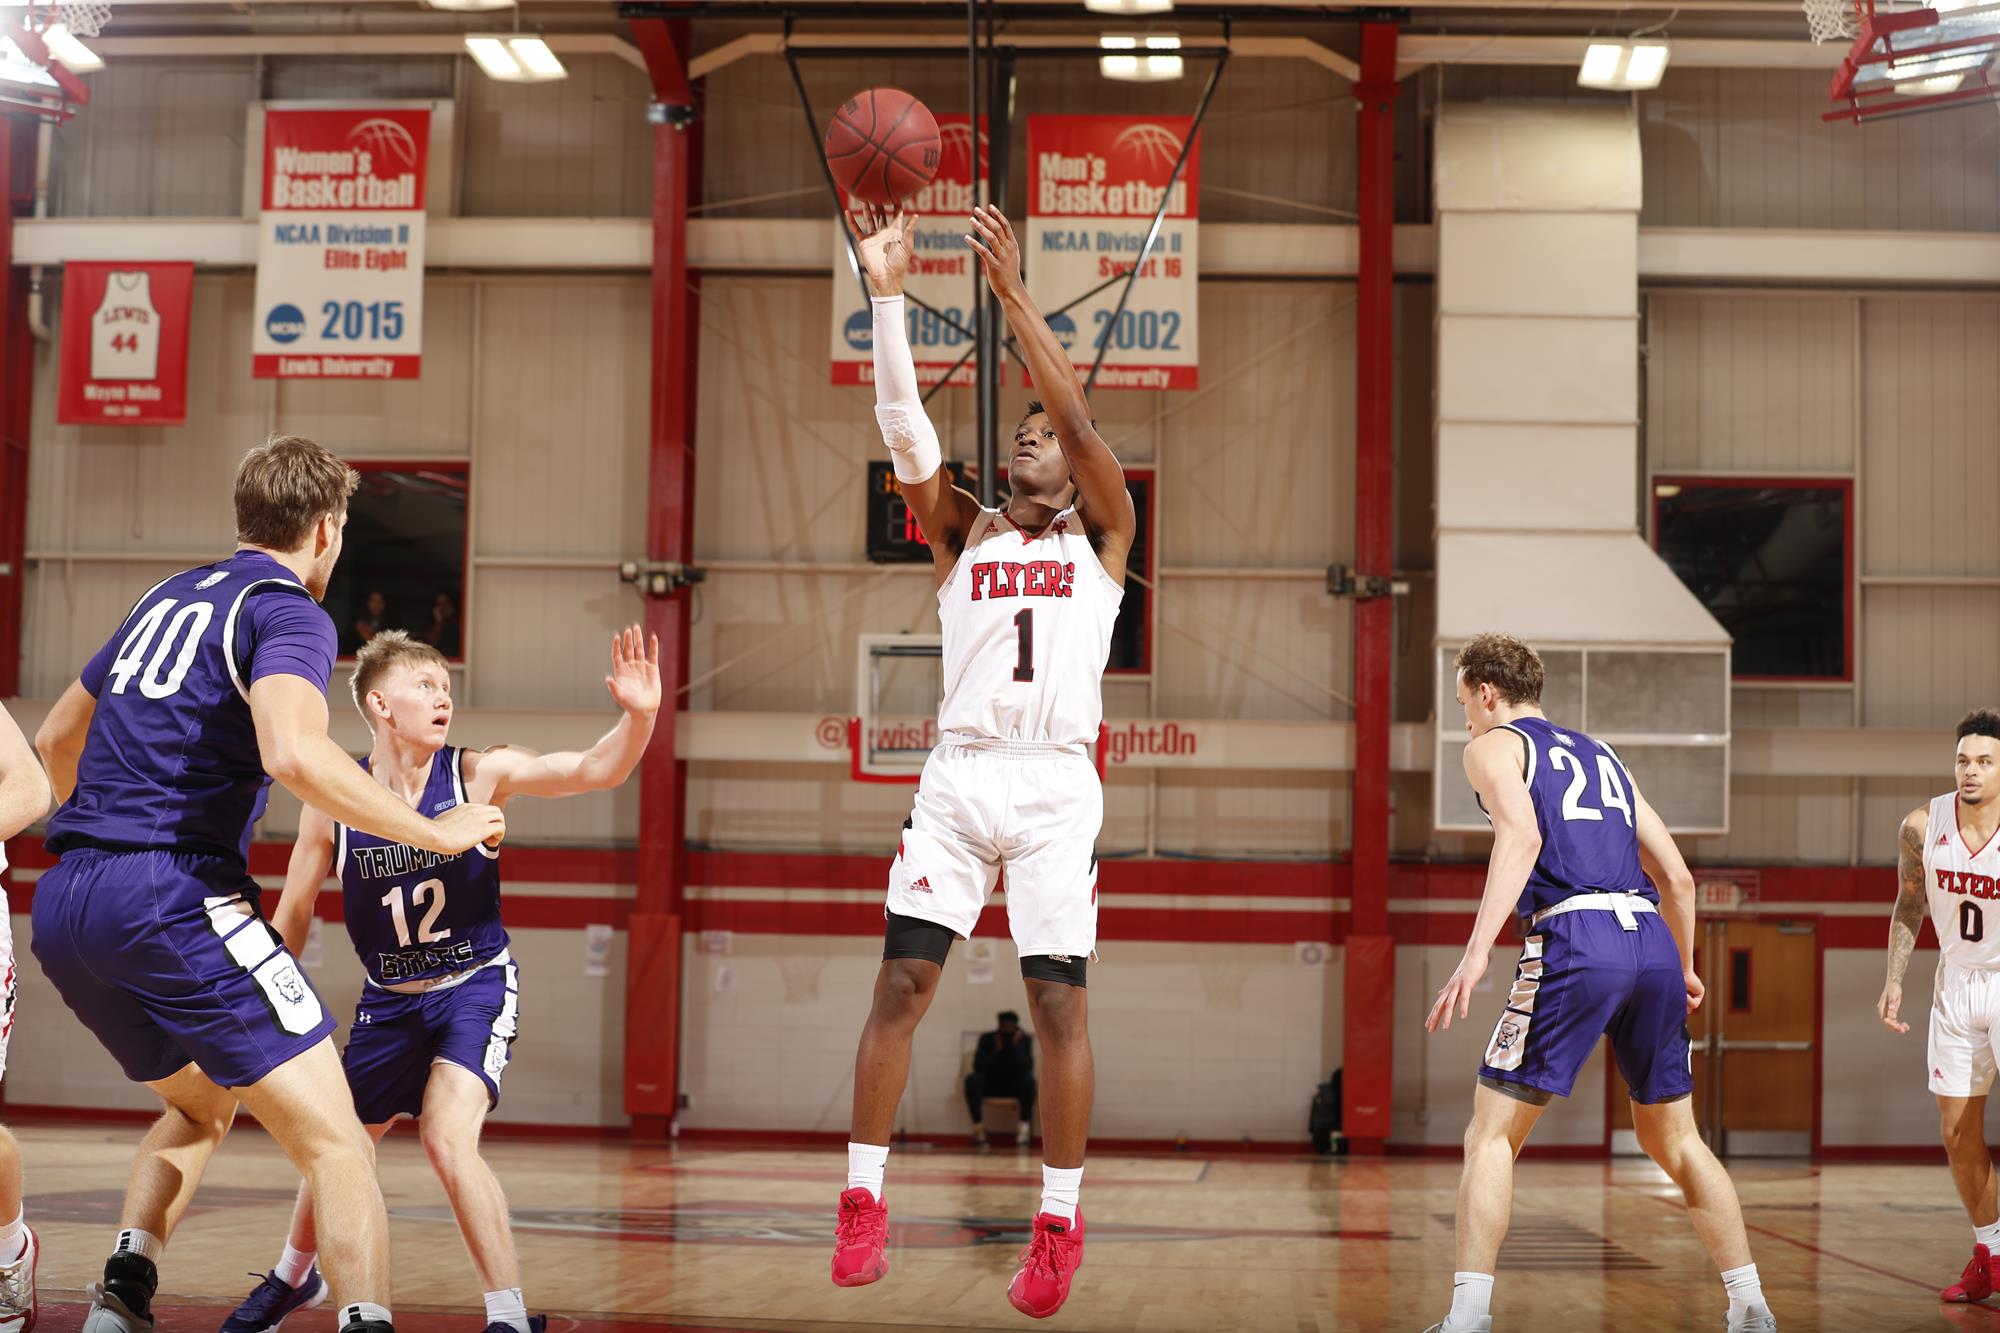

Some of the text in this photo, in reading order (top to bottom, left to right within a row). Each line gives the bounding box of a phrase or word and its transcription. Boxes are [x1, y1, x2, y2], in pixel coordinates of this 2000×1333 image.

[275, 147, 371, 174] Women's
[1039, 153, 1106, 181] Men's
[273, 173, 415, 208] Basketball
[1039, 180, 1187, 215] Basketball
[275, 224, 409, 244] NCAA Division II
[1042, 231, 1089, 252] NCAA
[1172, 233, 1182, 252] II
[324, 249, 407, 271] Elite Eight
[908, 255, 965, 275] Sweet
[1165, 258, 1182, 278] 16
[104, 307, 150, 325] LEWIS
[321, 300, 404, 340] 2015
[1093, 309, 1181, 350] 2002
[111, 332, 138, 353] 44
[278, 357, 394, 378] Lewis University
[971, 560, 1075, 601] FLYERS
[108, 598, 214, 699] 40
[1013, 608, 1034, 682] 1
[1548, 746, 1635, 829] 24
[352, 843, 463, 879] TRUMA
[381, 878, 451, 948] 12
[1959, 900, 1983, 942] 0
